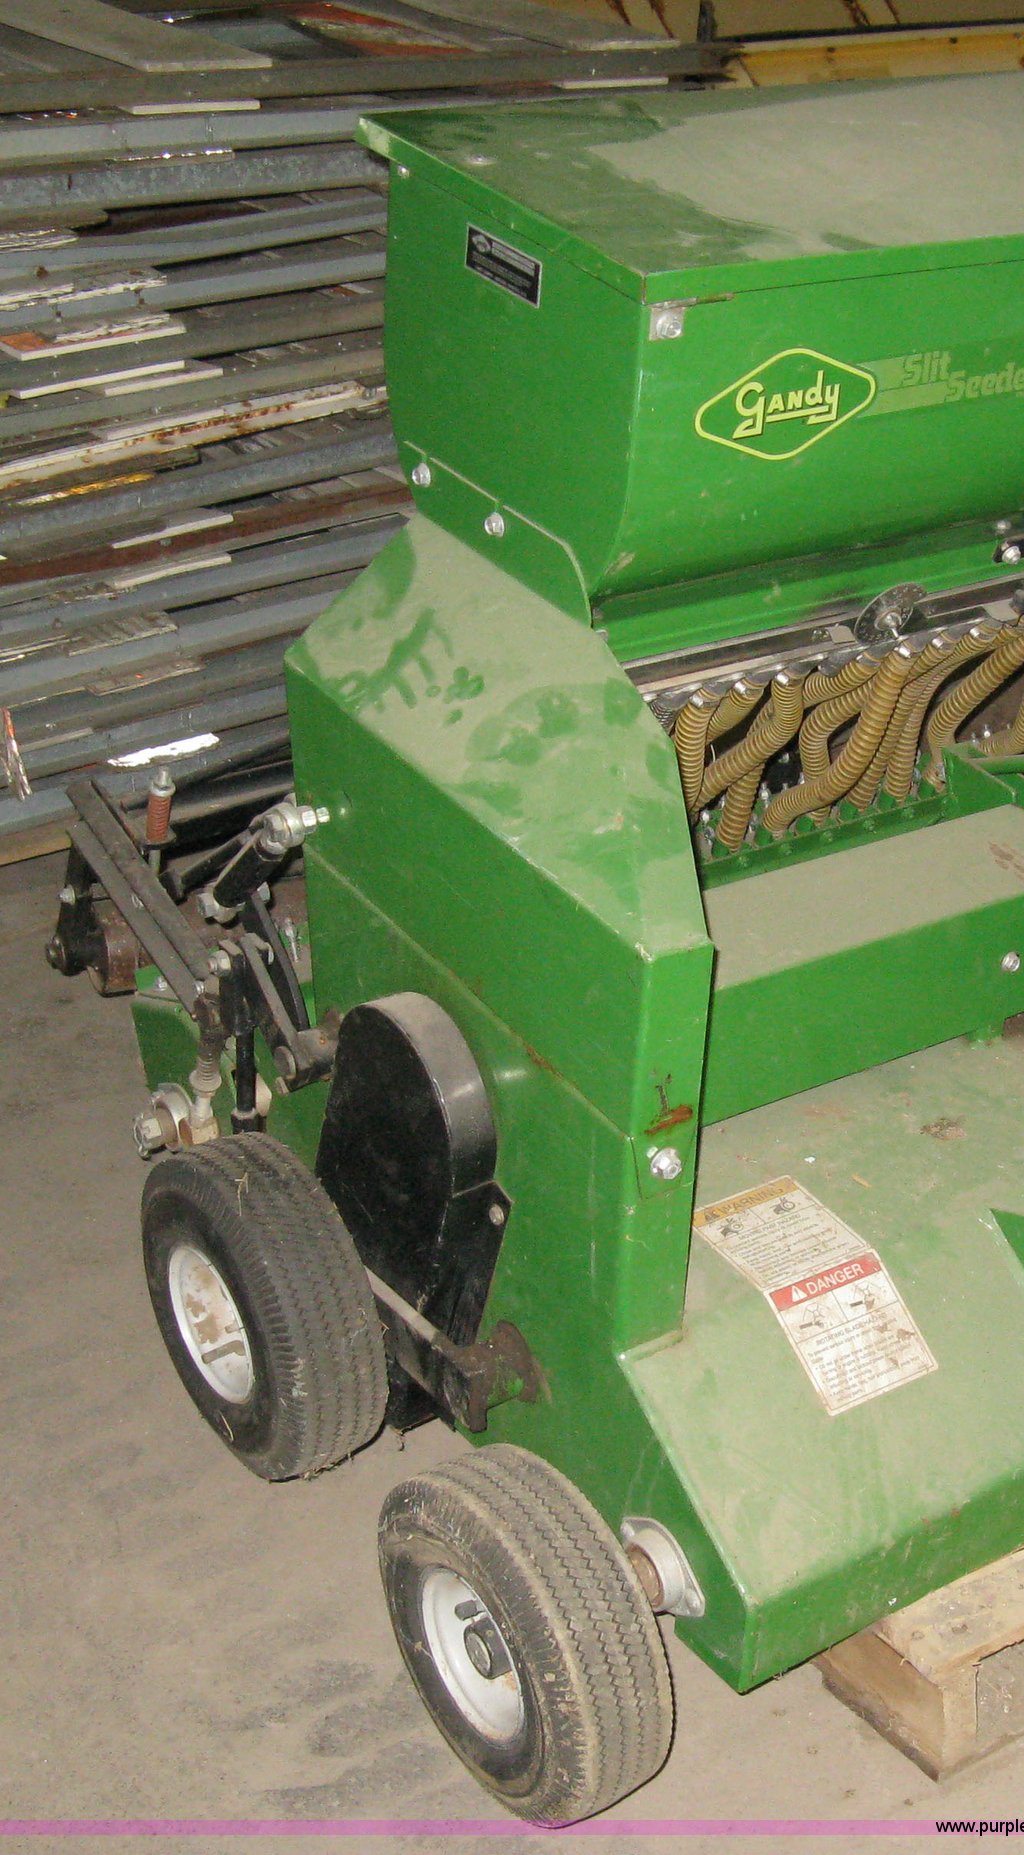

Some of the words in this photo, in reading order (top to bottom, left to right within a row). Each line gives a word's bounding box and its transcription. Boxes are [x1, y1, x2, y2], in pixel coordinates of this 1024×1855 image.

[902, 350, 951, 385] Slit
[719, 1186, 783, 1216] WARNING
[804, 1262, 864, 1294] DANGER
